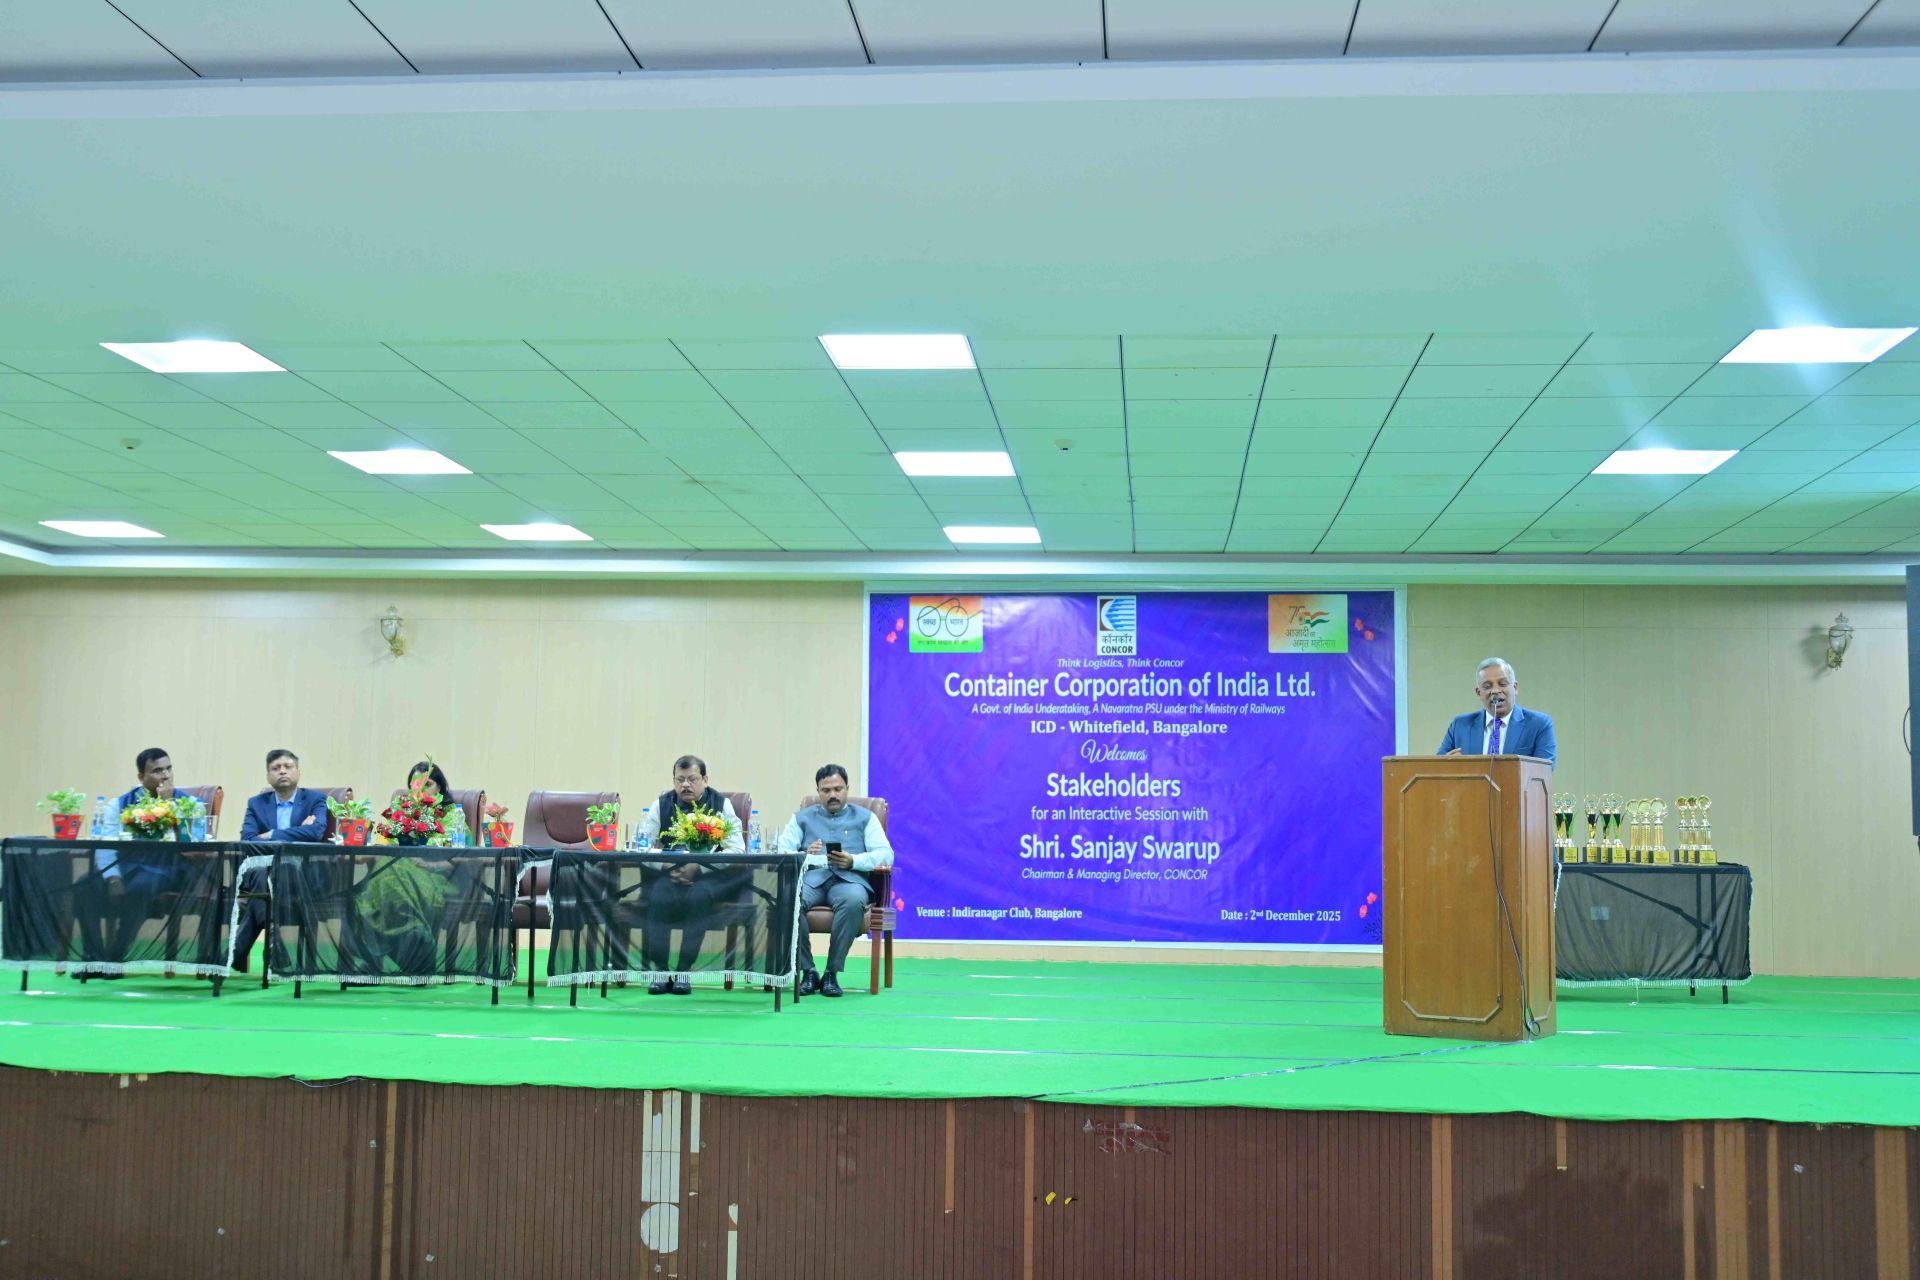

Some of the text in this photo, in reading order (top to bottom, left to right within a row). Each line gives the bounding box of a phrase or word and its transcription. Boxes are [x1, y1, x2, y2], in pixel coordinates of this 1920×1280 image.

[1101, 633, 1133, 644] कॉनकॉर
[1101, 645, 1134, 654] CONCOR
[1057, 658, 1185, 669] Think Logistics, Think Concor
[944, 672, 1316, 701] Container Corporation of India Ltd.
[971, 703, 1286, 716] A Govt. of India Underataking, A Navaratna PSU under the Ministry of Railways
[1030, 720, 1057, 733] ICD
[1069, 720, 1149, 735] Whitefield,
[1152, 720, 1228, 737] Bangalore
[1080, 739, 1147, 764] Welcomes
[1046, 772, 1181, 797] Stakeholders
[1031, 806, 1209, 821] for an Interactive Session with
[1019, 834, 1220, 864] Shri. Sanjay Swarup
[1022, 867, 1208, 882] Chairman & Managing Director, CONCOR
[916, 906, 946, 917] Venue
[952, 907, 1008, 920] Indiranagar
[1009, 907, 1033, 919] Club,
[1034, 908, 1083, 920] Bangalore
[1220, 909, 1243, 920] Date
[1250, 909, 1264, 920] 2nd
[1265, 910, 1315, 921] December
[1316, 910, 1341, 921] 2025
